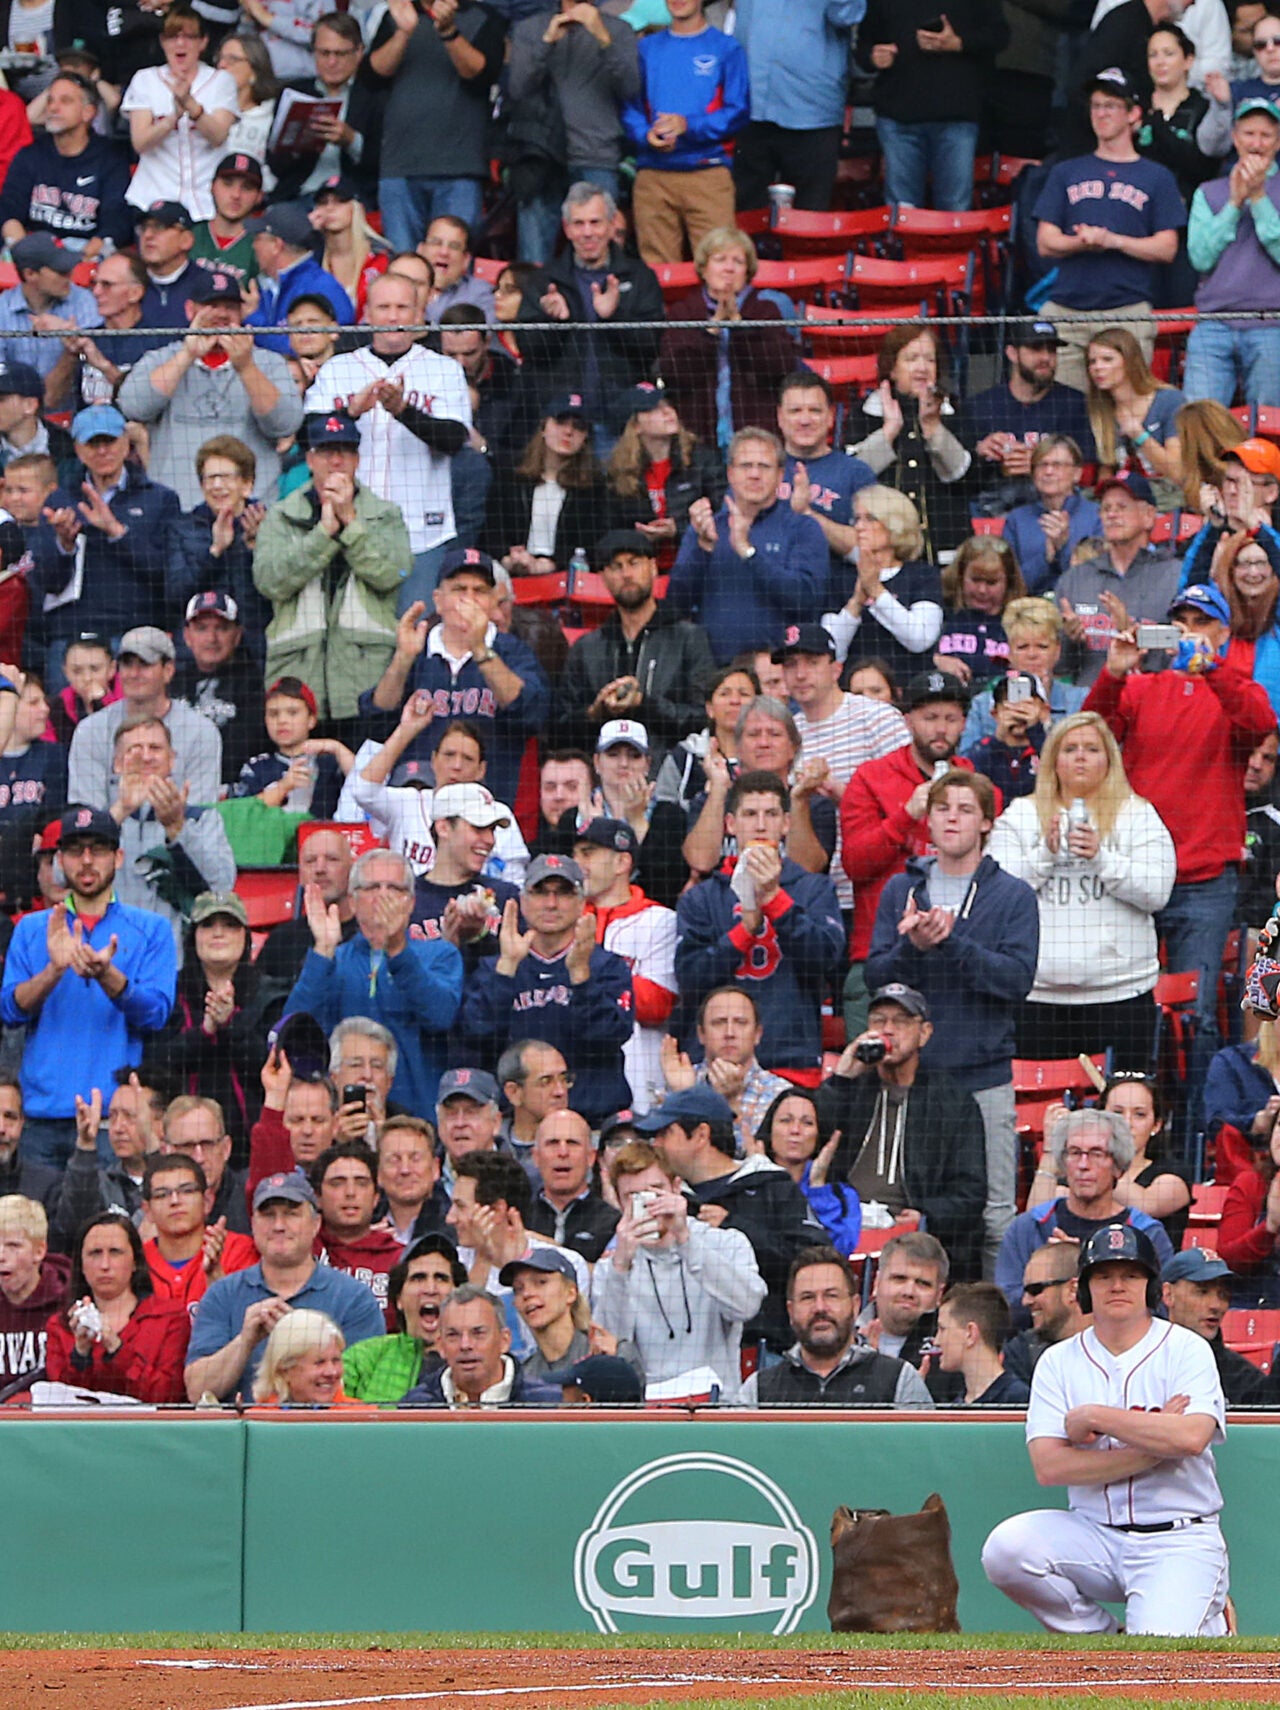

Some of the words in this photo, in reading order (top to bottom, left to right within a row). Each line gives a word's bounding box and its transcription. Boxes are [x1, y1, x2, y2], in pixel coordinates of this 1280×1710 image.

[1067, 180, 1105, 205] RED
[1108, 1230, 1126, 1249] B
[594, 1537, 799, 1599] Gulf
